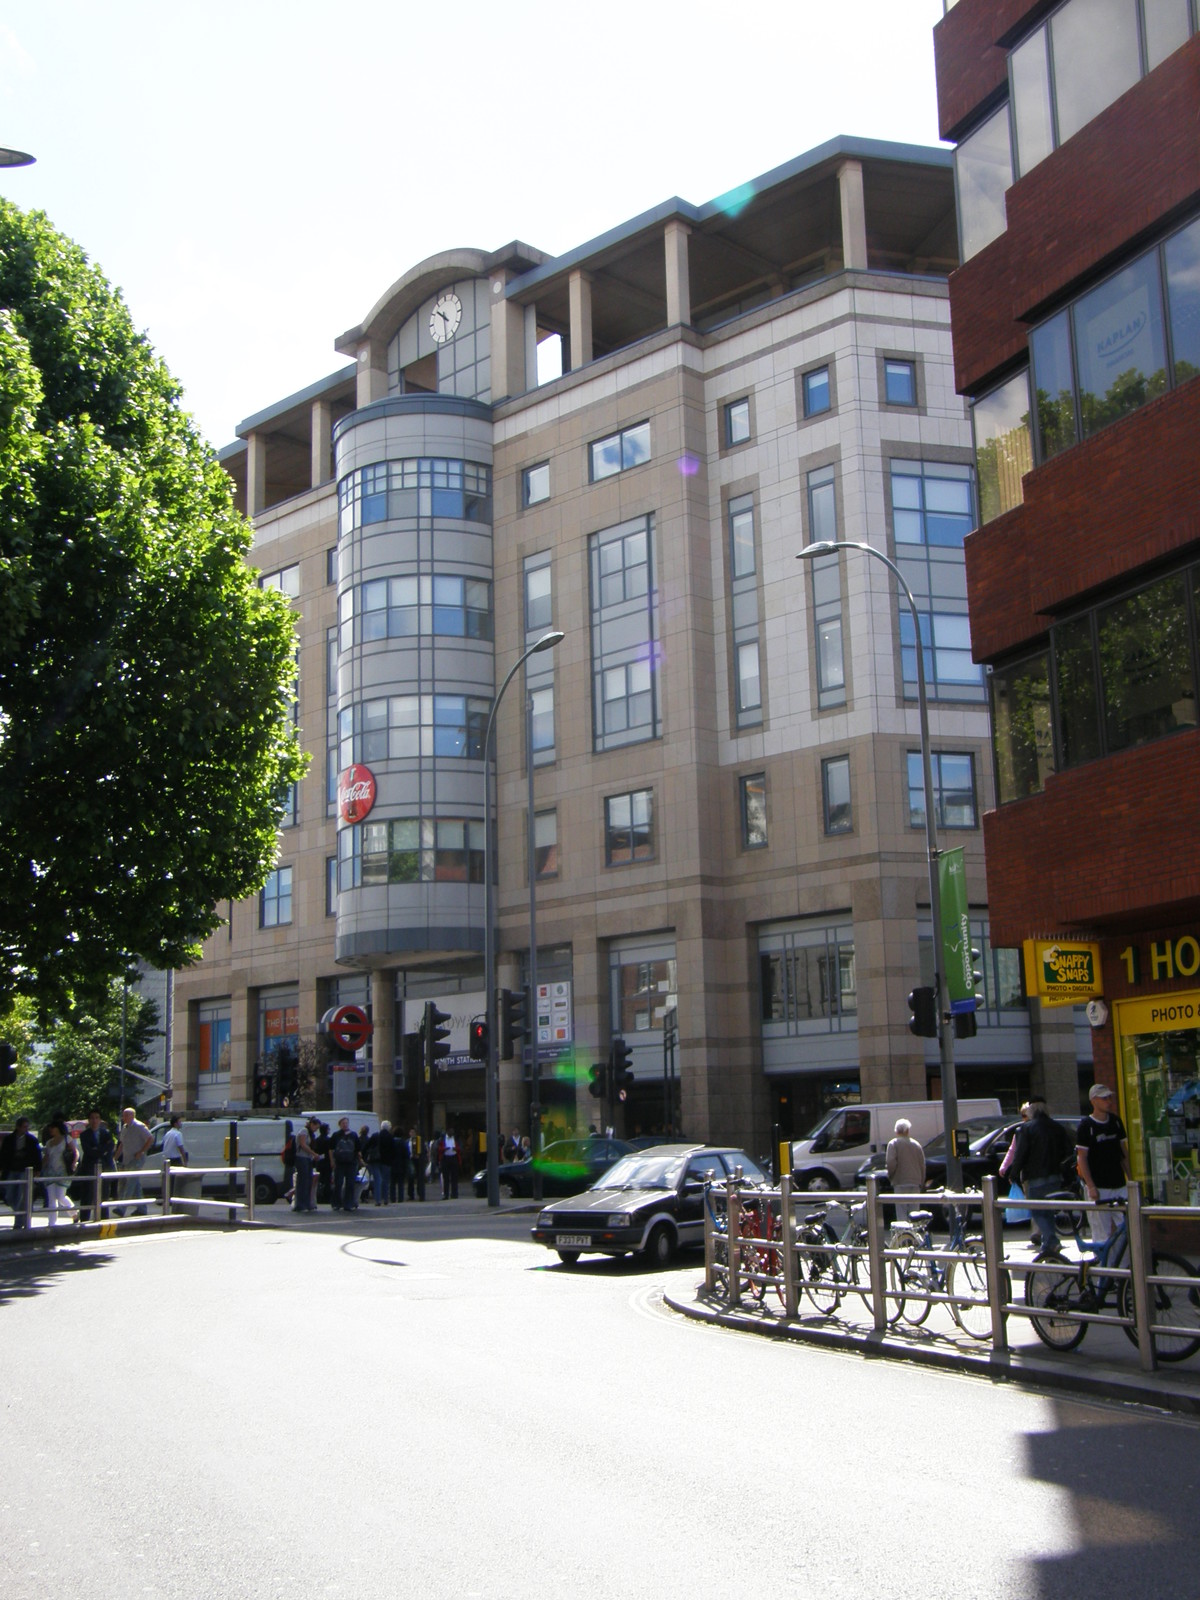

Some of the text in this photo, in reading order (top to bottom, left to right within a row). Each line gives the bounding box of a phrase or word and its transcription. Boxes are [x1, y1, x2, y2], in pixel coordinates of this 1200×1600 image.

[1096, 317, 1141, 354] KAPLAN
[960, 913, 973, 990] Opportunity
[1049, 951, 1090, 971] SNAPPY
[1120, 935, 1200, 984] 1 HO
[1056, 967, 1090, 983] SNAPS
[1046, 984, 1068, 992] PHOTO
[1151, 1004, 1194, 1022] PHOTO
